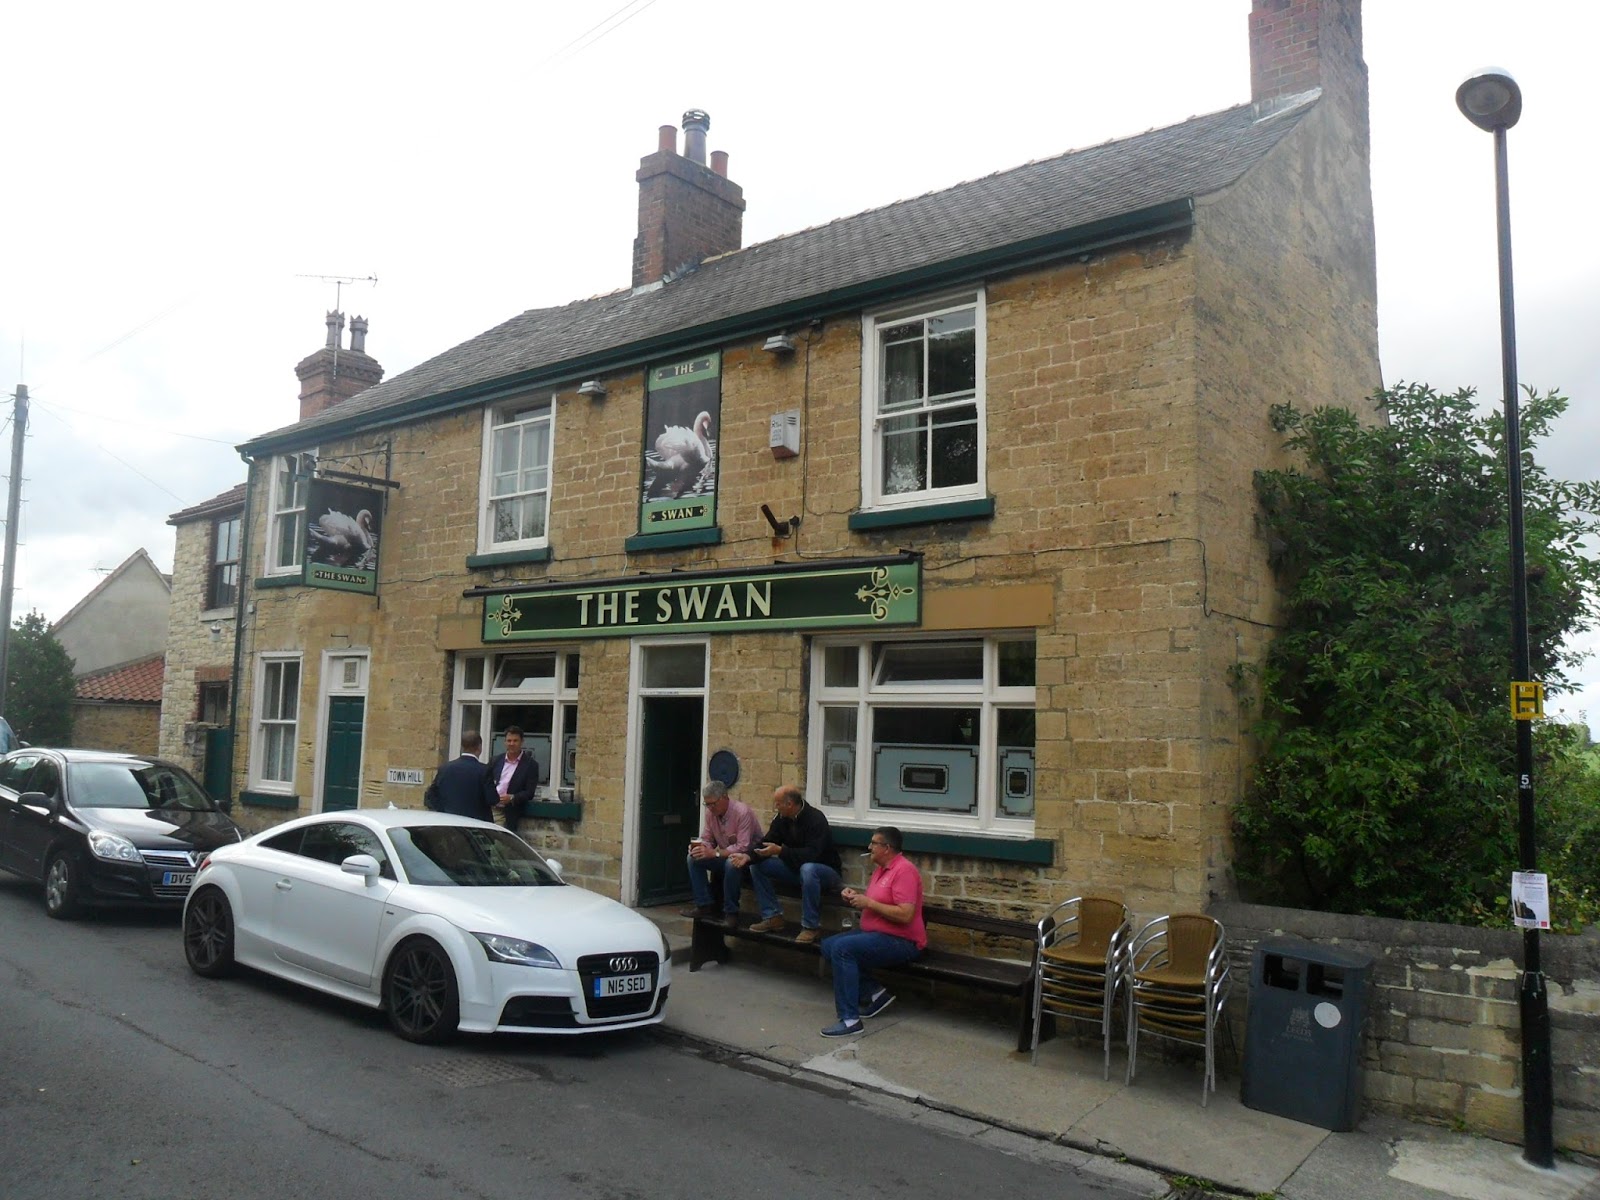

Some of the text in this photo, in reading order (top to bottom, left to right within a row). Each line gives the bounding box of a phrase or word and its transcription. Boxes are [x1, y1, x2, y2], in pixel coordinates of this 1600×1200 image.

[674, 362, 694, 376] THE
[661, 507, 694, 521] SWAN
[319, 571, 363, 583] THE SWAN
[577, 582, 771, 625] THE SWAN
[389, 770, 422, 783] TOWN HILL
[1521, 774, 1530, 785] 5
[170, 874, 197, 884] DV5
[627, 977, 646, 991] SED
